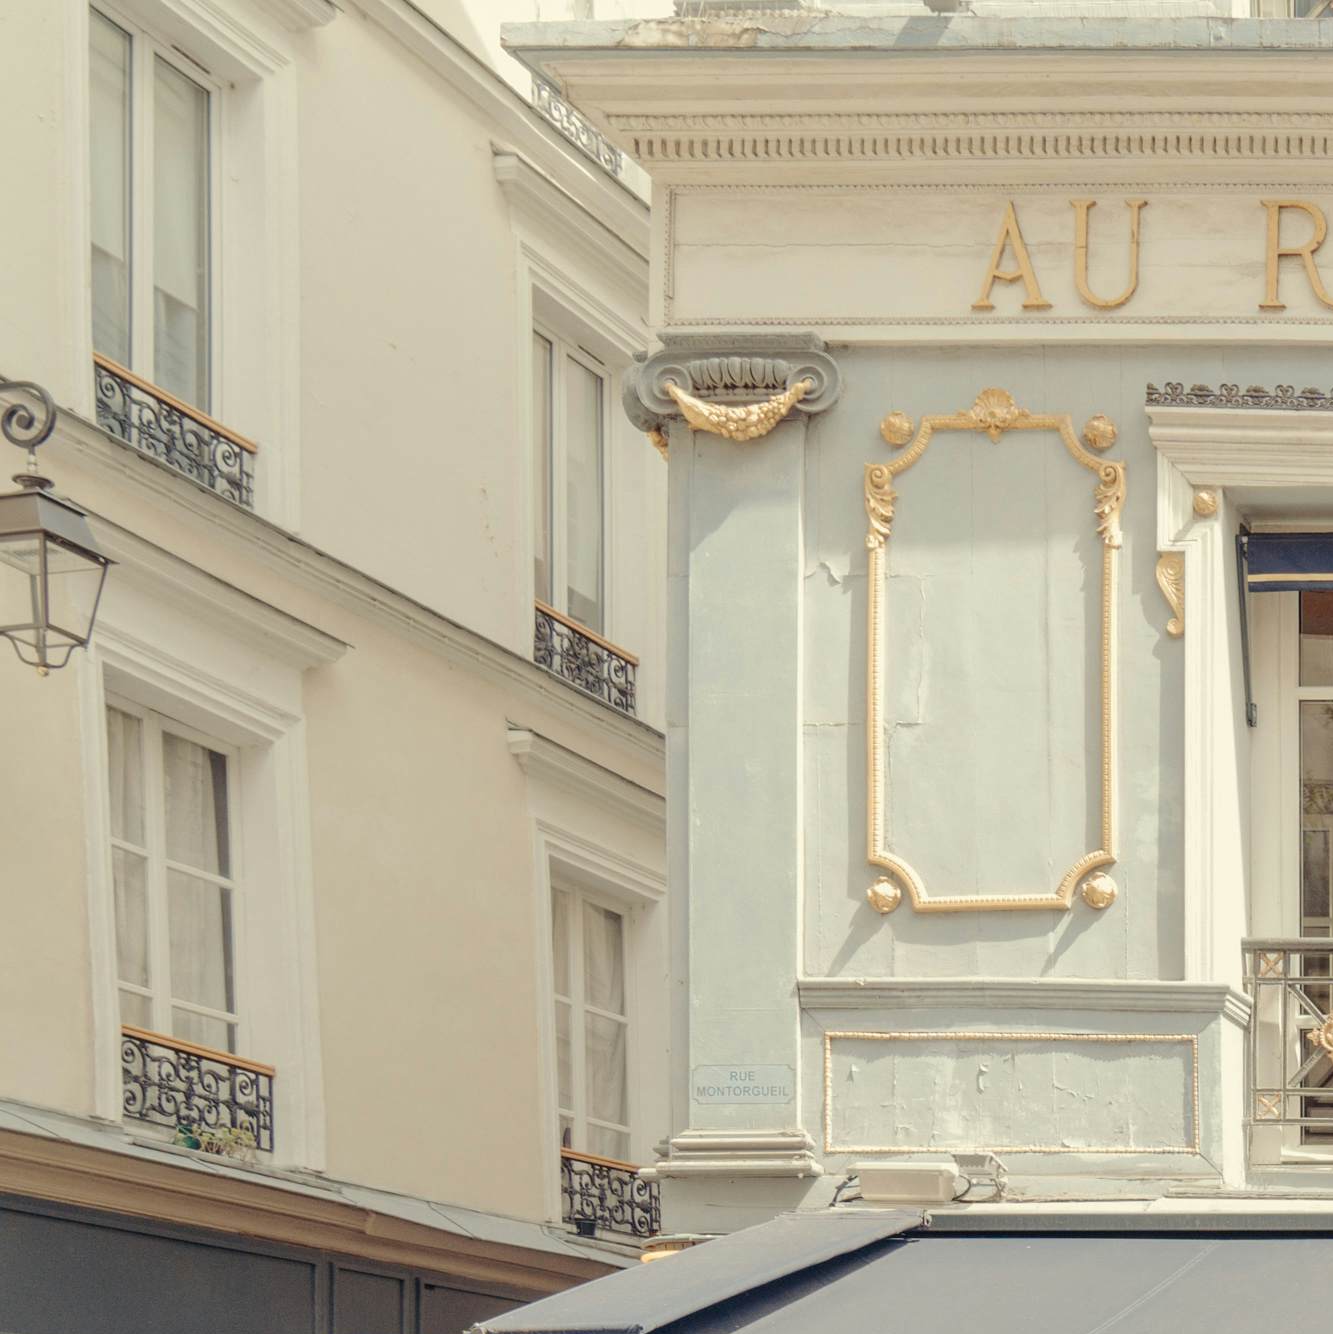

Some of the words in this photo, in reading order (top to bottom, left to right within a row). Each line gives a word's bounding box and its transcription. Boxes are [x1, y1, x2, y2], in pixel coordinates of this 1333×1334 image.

[971, 200, 1147, 312] AU
[729, 1071, 755, 1081] RUE
[697, 1086, 789, 1096] MONTORGUEIL
